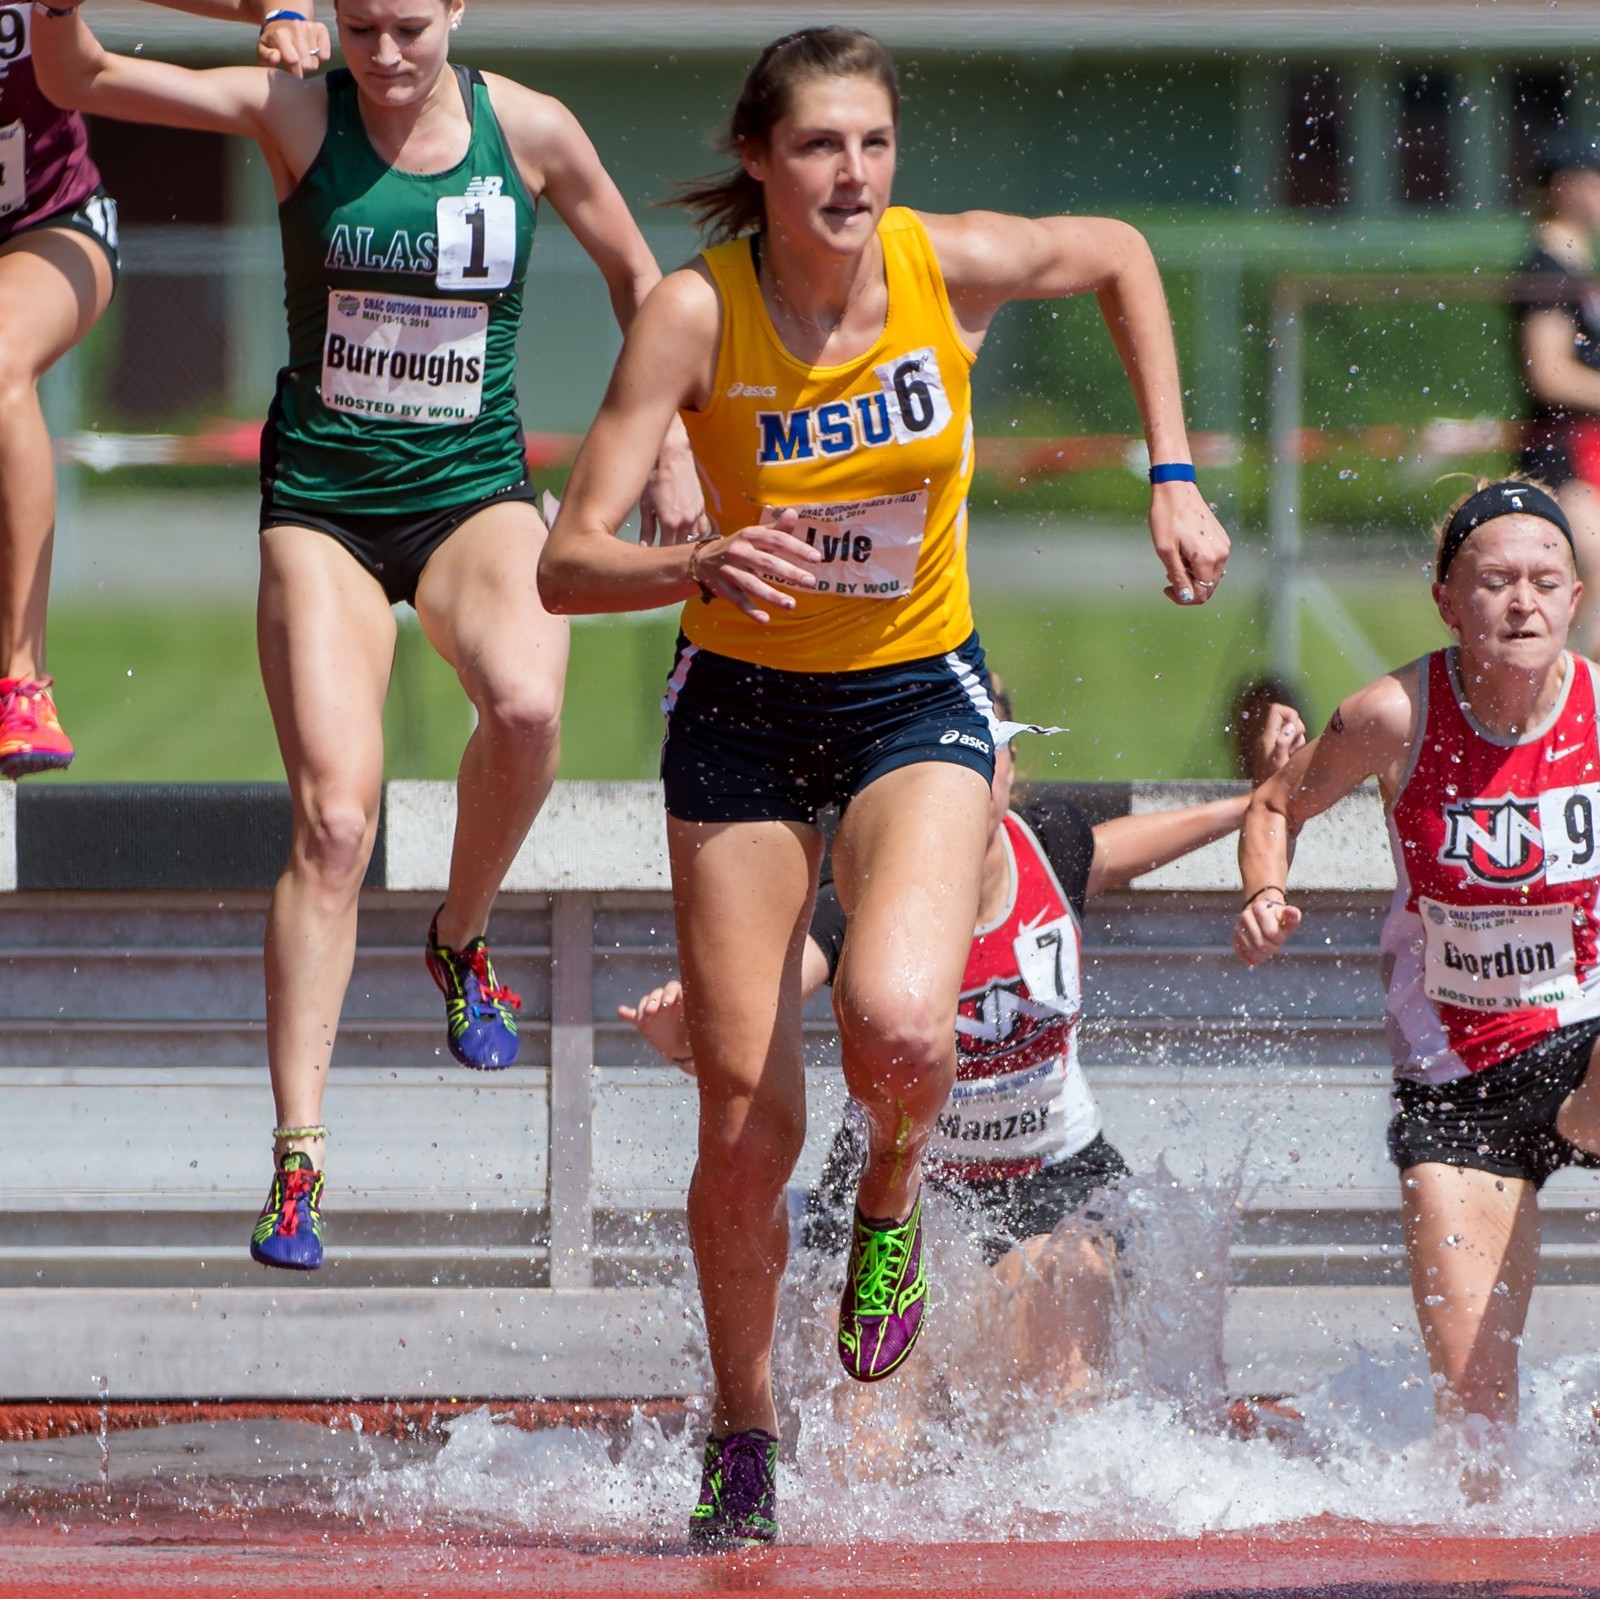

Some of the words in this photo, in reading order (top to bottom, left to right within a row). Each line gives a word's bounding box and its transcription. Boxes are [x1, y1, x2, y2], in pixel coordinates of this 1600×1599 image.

[0, 8, 25, 60] 9
[324, 224, 439, 276] ALAS
[462, 208, 489, 279] 1
[362, 311, 380, 322] MAY
[409, 318, 430, 328] 2016
[363, 298, 384, 311] GNAC
[386, 301, 422, 316] OUTDOOR
[424, 305, 448, 318] TRACK
[457, 306, 477, 319] FIELD
[327, 333, 480, 387] Burroughs
[334, 394, 395, 414] HOSTED
[401, 405, 422, 417] BY
[428, 407, 465, 418] WOU
[893, 359, 935, 433] 6
[756, 390, 896, 466] MSU
[836, 582, 858, 593] BY
[863, 580, 900, 593] WOU
[959, 733, 990, 754] asics
[1564, 793, 1595, 866] 9
[1448, 909, 1470, 921] GNAC
[1508, 908, 1533, 917] TRACK
[1036, 928, 1068, 1000] 7
[1443, 940, 1556, 980] Gordon
[1438, 986, 1497, 1007] HOSTED
